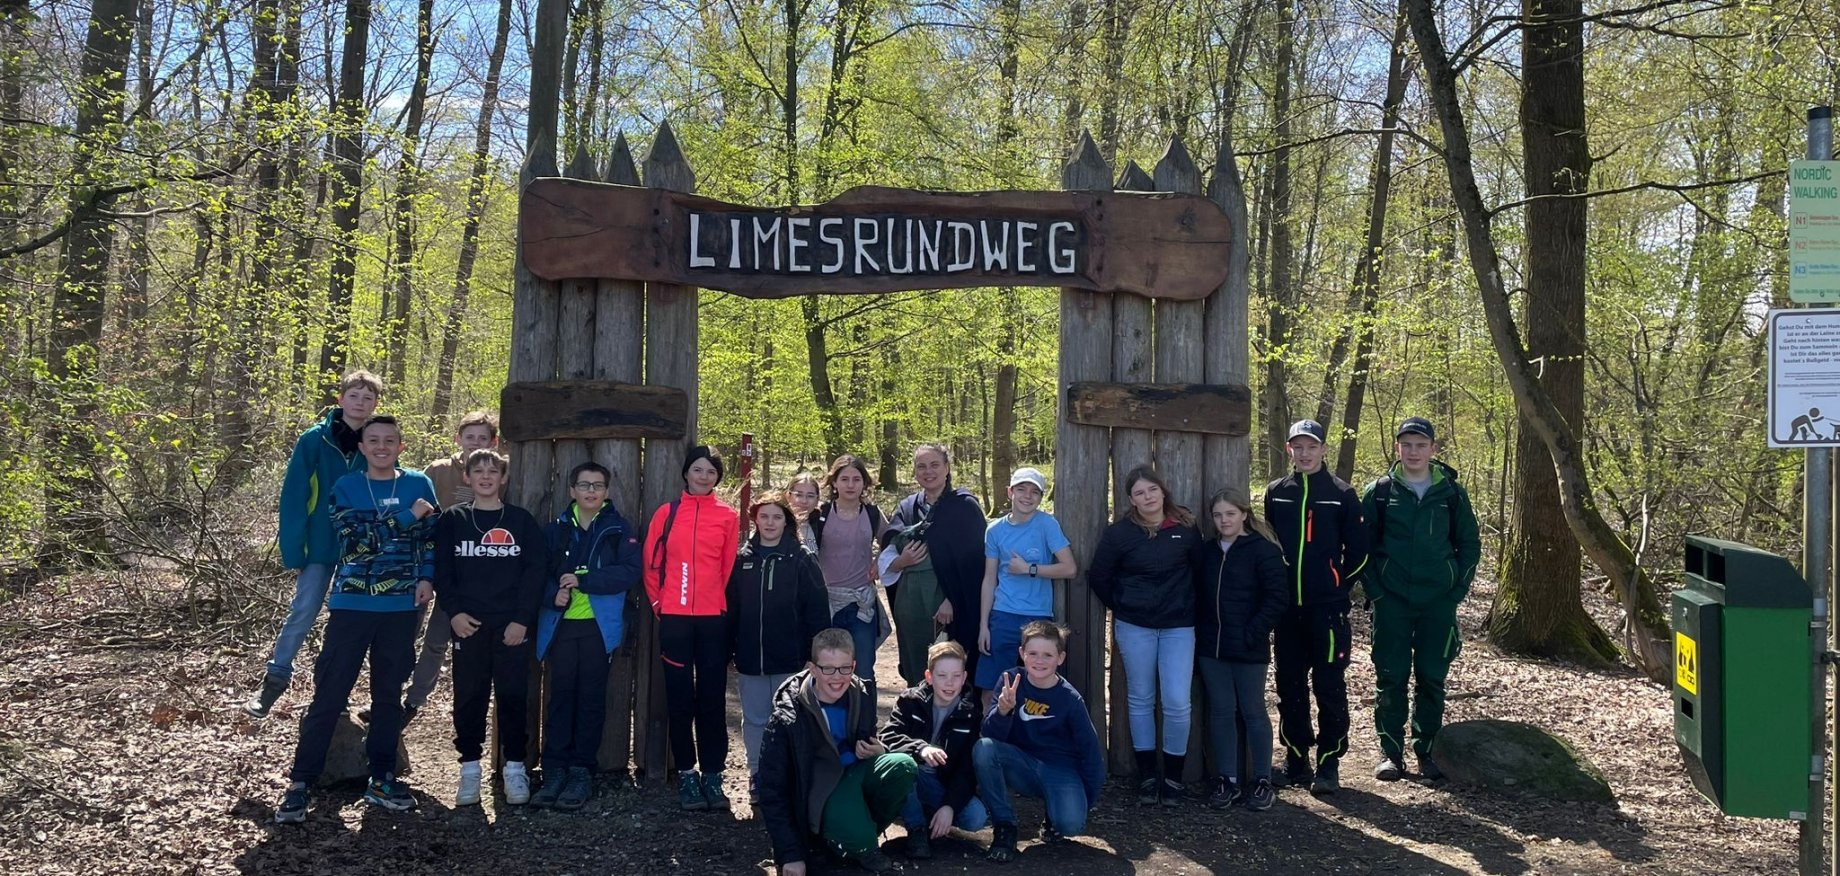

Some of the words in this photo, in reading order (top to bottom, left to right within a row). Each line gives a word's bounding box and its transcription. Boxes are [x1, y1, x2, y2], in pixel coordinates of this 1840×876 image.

[1793, 168, 1832, 181] NORDIC
[1793, 187, 1838, 199] WALKING
[1795, 216, 1806, 225] N1
[689, 213, 1076, 274] LIMESRUNDWEG
[1795, 241, 1806, 250] N2
[1795, 265, 1806, 274] N3
[455, 541, 521, 557] ellesse
